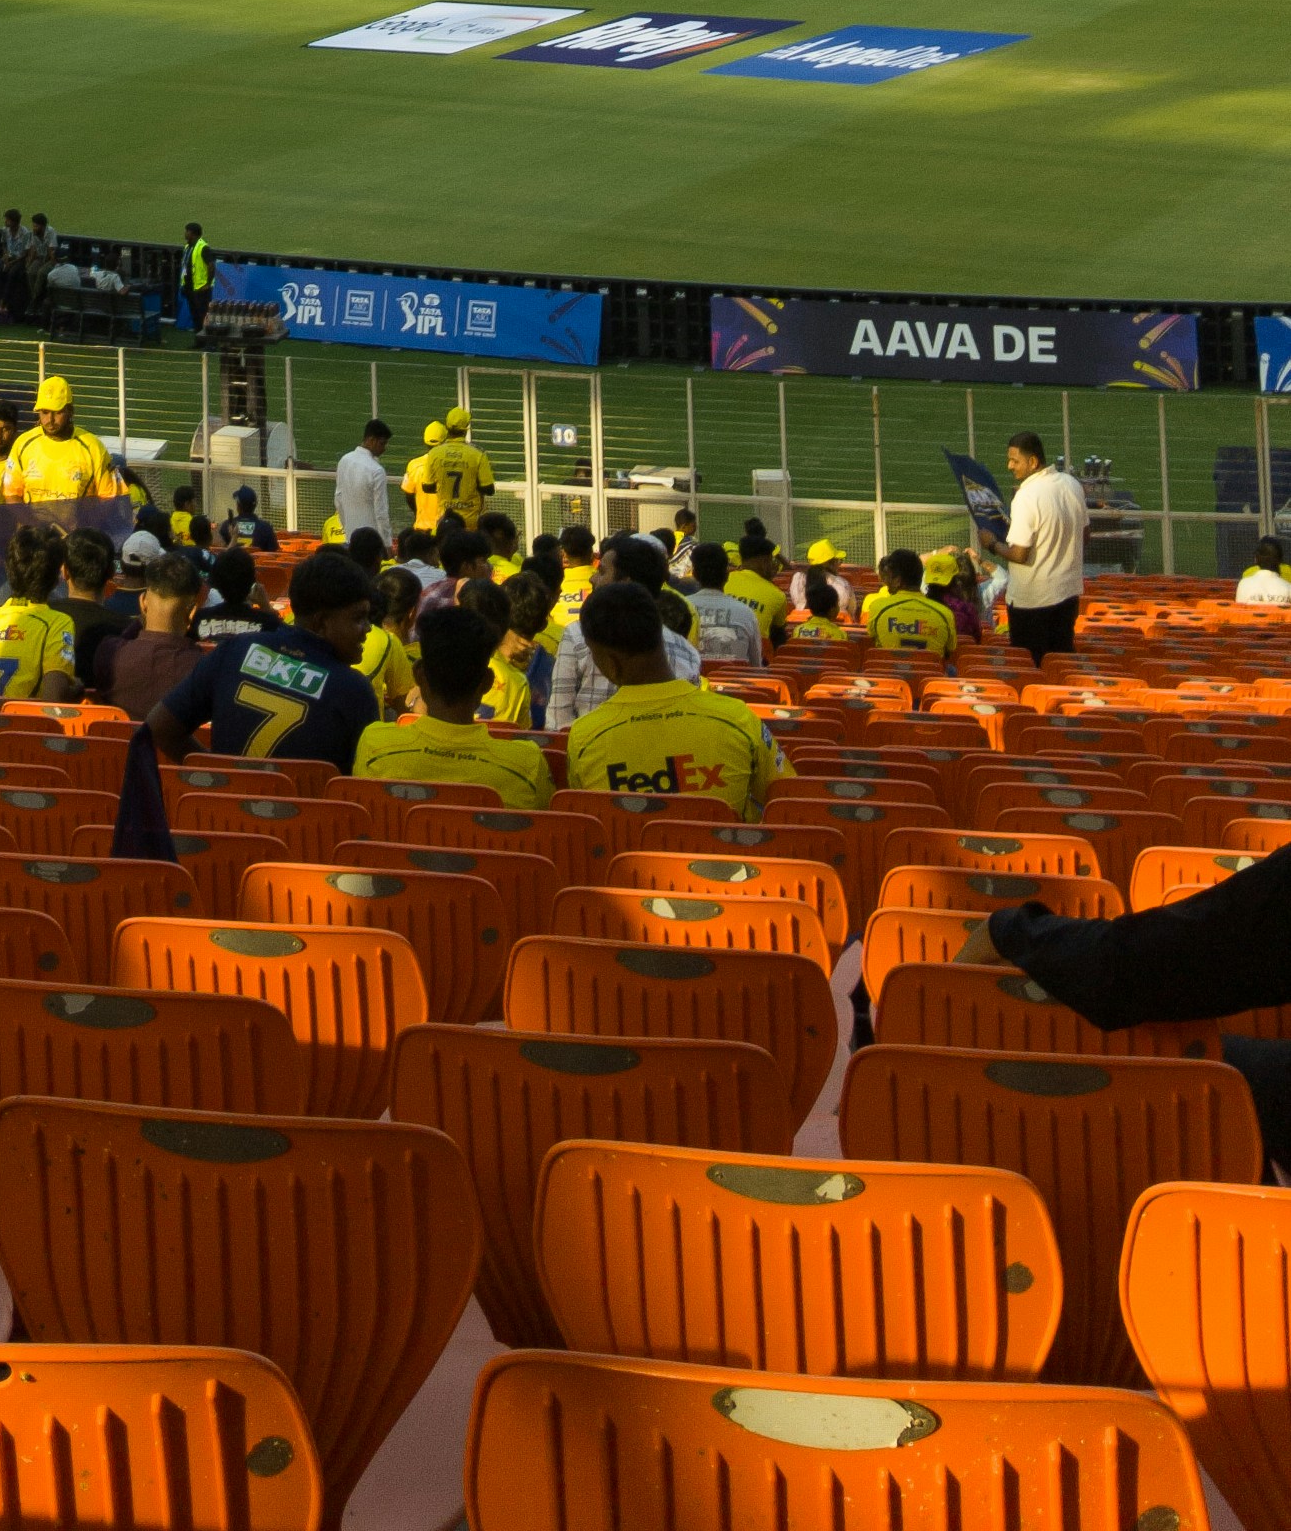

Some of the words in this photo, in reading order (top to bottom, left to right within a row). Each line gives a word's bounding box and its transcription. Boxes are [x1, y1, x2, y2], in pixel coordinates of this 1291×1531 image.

[536, 17, 741, 63] RuPay
[300, 297, 321, 306] TATA
[419, 307, 441, 316] TATA
[296, 305, 326, 326] IPL
[415, 315, 447, 336] IPL
[849, 319, 981, 361] AAVA
[993, 324, 1058, 364] DE
[554, 427, 575, 443] 10
[447, 470, 463, 499] 7
[888, 616, 939, 636] FedEx
[246, 649, 324, 688] BKT
[234, 680, 309, 759] 7
[607, 753, 728, 794] FedEx
